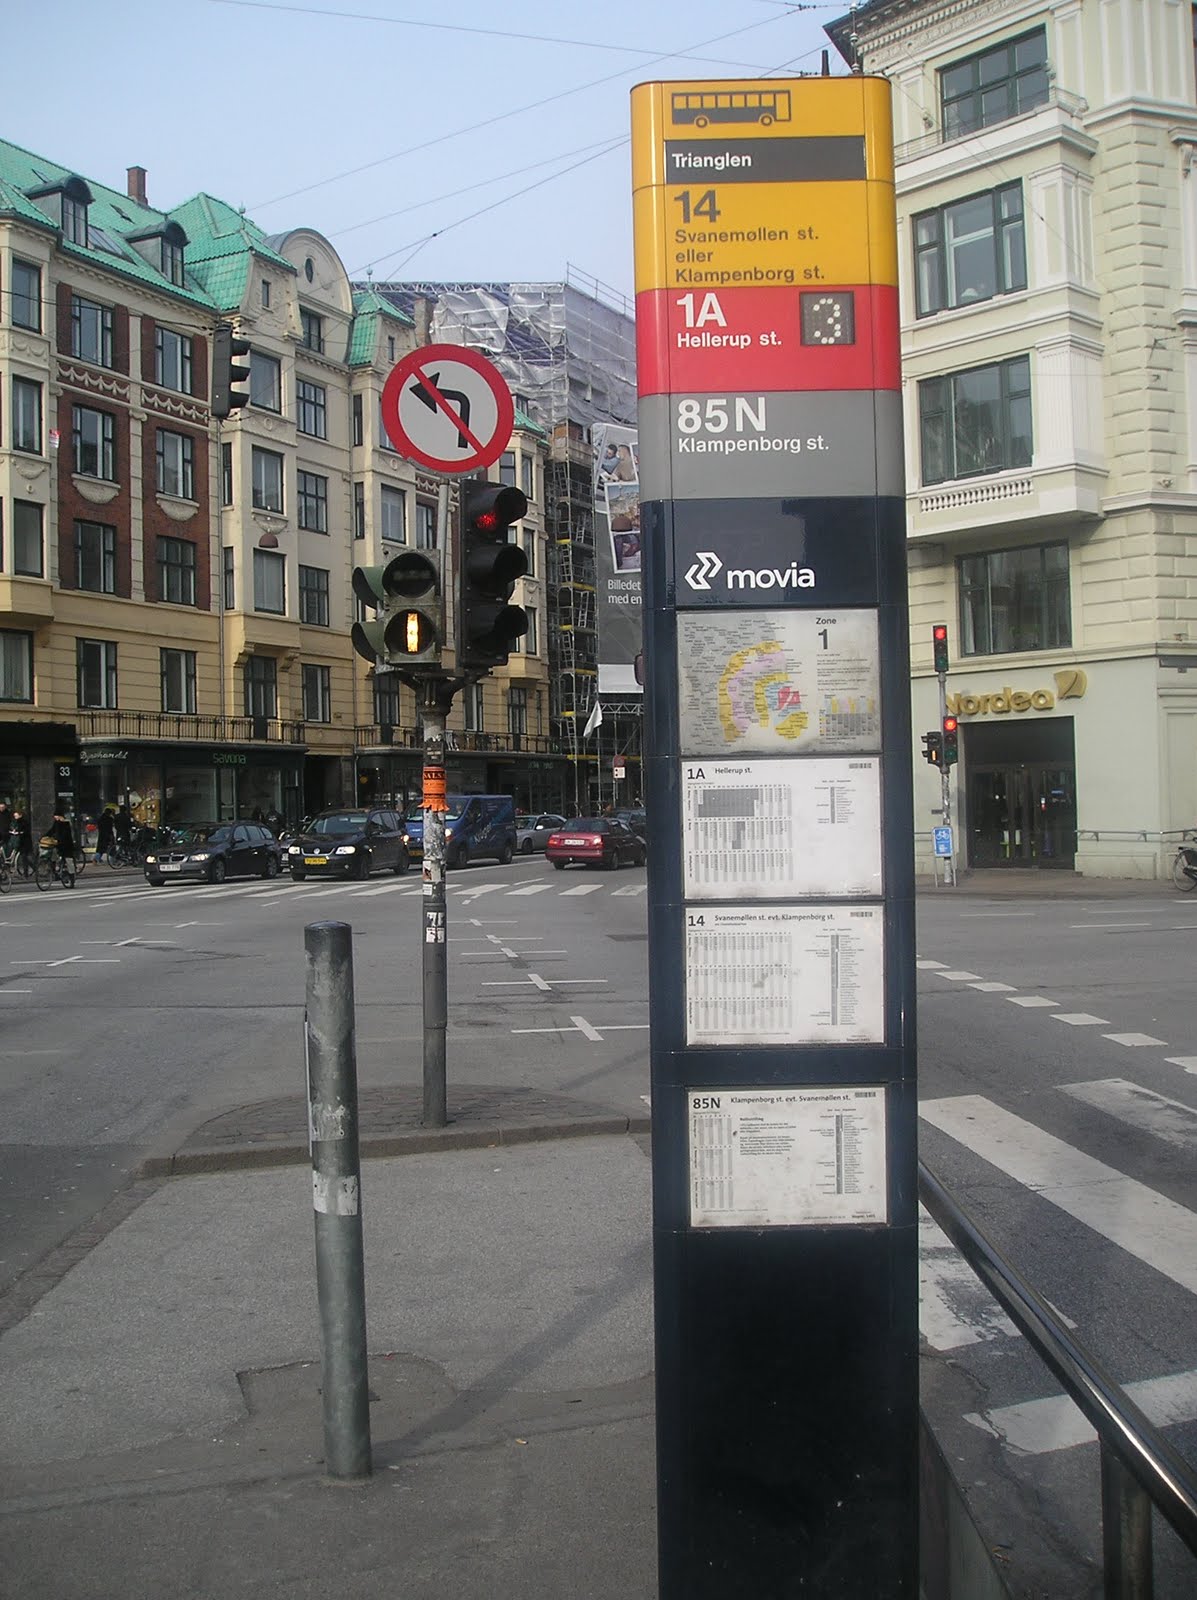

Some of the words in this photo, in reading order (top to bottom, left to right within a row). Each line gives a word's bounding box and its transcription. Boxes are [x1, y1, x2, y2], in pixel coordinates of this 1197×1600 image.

[671, 152, 752, 170] Trianglen
[673, 189, 721, 224] 14
[674, 227, 789, 244] Svanemøllen
[797, 226, 819, 241] st.
[675, 249, 714, 263] eller
[675, 266, 795, 284] Klampenborg
[803, 266, 825, 280] st.
[676, 292, 728, 328] 1A
[677, 332, 752, 349] Hellerup
[759, 331, 782, 346] st.
[678, 436, 801, 455] Klampenborg
[806, 435, 829, 451] st.
[727, 562, 816, 589] movia
[607, 579, 642, 591] Billedet
[608, 593, 629, 604] med
[815, 617, 837, 626] Zone
[818, 628, 829, 650] 1
[946, 687, 1056, 716] Nordea
[59, 766, 71, 777] 33
[687, 767, 706, 780] 1A
[714, 767, 744, 775] Hellerup
[687, 915, 706, 927] 14
[714, 914, 757, 922] Svanemøllen
[781, 914, 826, 922] Klampenborg
[692, 1097, 721, 1109] 85N
[730, 1097, 775, 1105] Klampenborg
[799, 1095, 842, 1103] Svanemøllen
